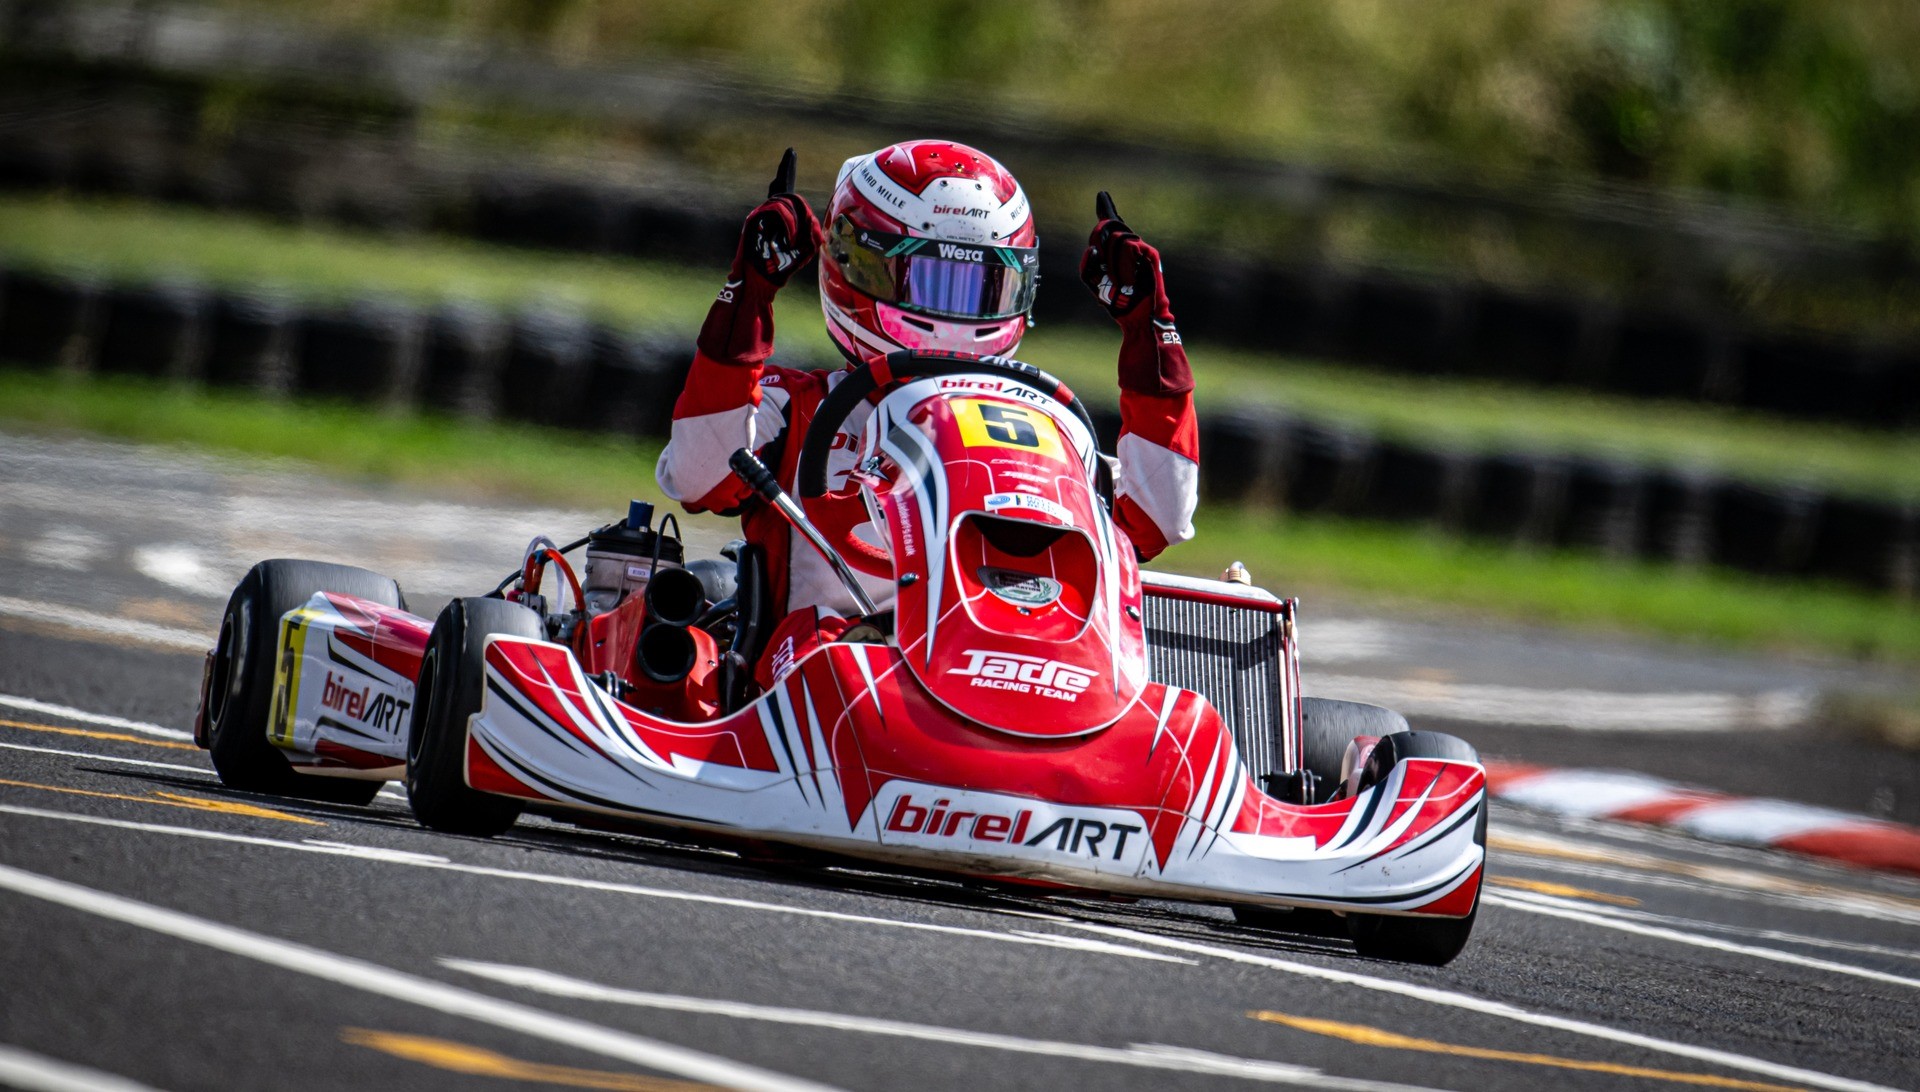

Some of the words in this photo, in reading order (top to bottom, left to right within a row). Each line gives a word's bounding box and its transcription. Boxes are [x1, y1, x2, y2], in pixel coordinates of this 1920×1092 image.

[876, 185, 906, 209] MILLE
[933, 204, 991, 220] birelART
[938, 243, 984, 263] Wera
[940, 378, 1052, 405] birelART
[977, 403, 1040, 448] 5
[274, 614, 306, 742] 5
[946, 649, 1101, 693] Jade
[321, 670, 411, 736] birelART
[970, 677, 1031, 693] RACING
[1034, 685, 1077, 703] TEAM
[884, 794, 1142, 861] birelART
